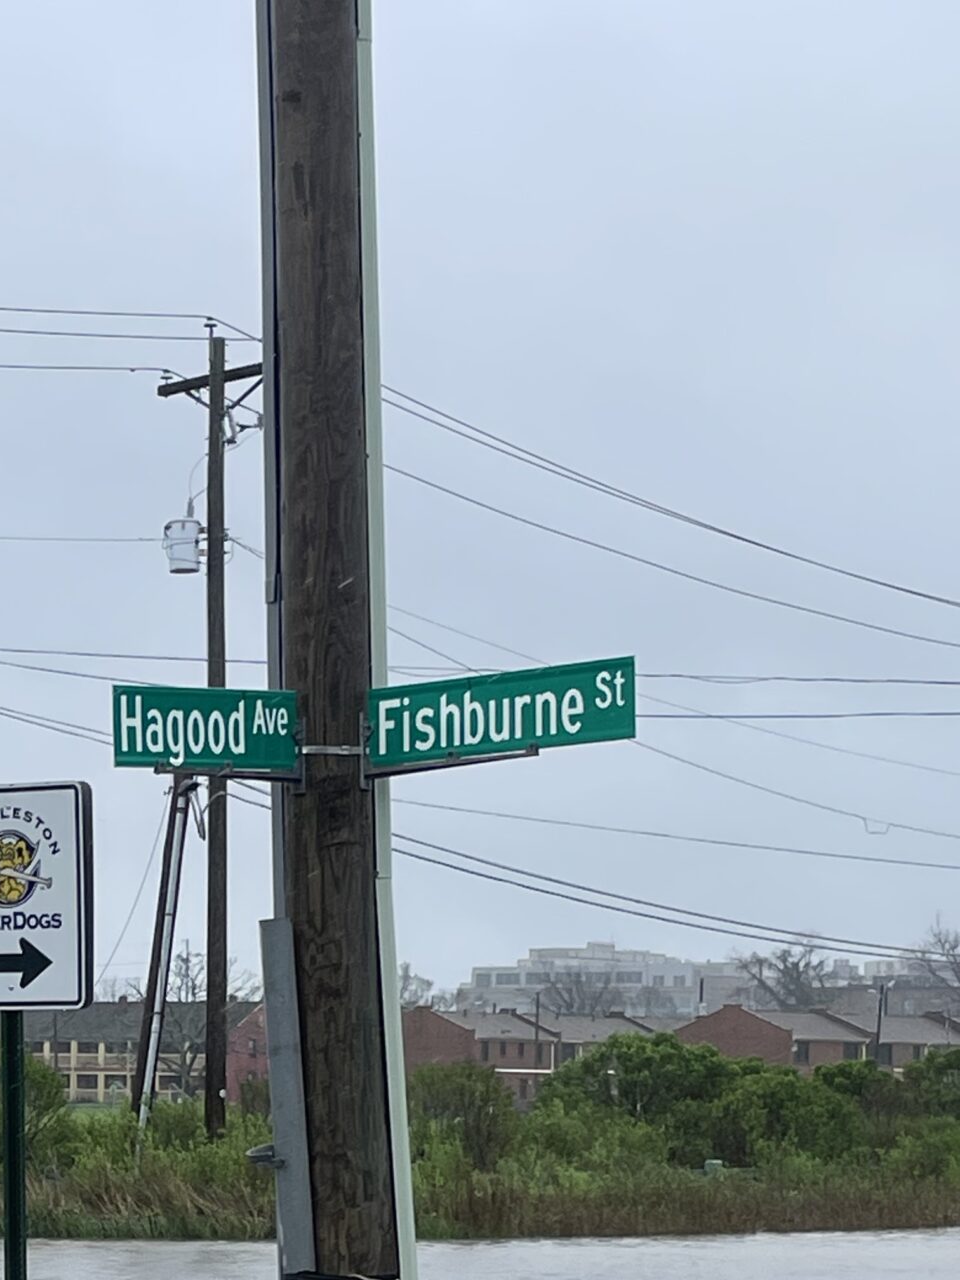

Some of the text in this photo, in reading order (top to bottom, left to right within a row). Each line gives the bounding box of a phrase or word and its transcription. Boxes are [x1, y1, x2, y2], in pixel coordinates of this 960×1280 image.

[120, 694, 289, 766] Hagood Ave
[378, 670, 626, 755] Fishburne St
